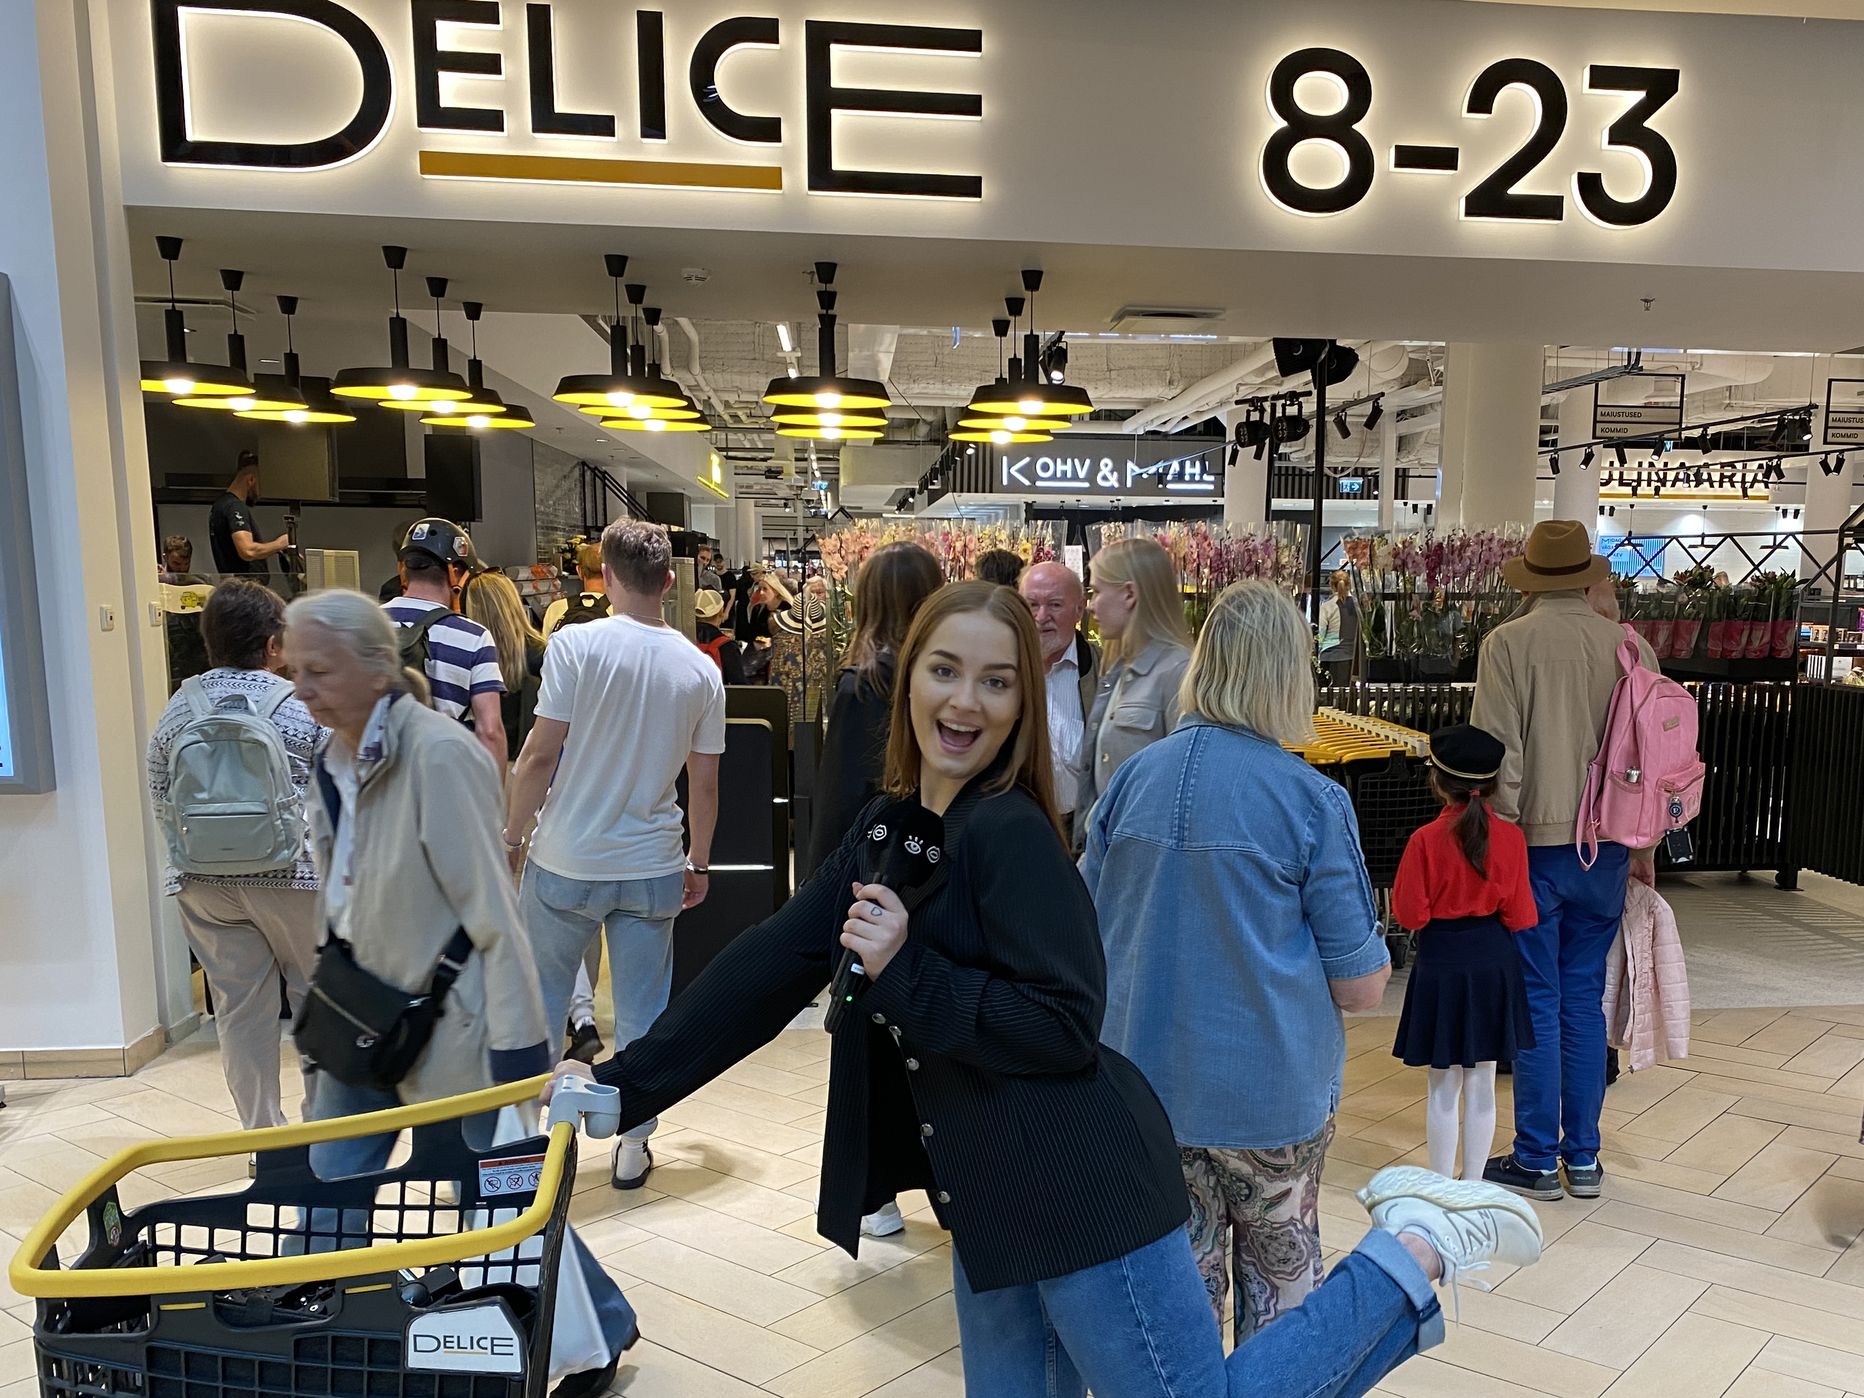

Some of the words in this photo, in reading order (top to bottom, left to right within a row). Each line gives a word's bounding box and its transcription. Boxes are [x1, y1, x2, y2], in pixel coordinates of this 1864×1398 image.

[152, 0, 983, 199] DELICE
[1261, 46, 1681, 228] 8-23
[1600, 410, 1642, 418] MAIUSTUSED
[1831, 416, 1864, 424] MAIUSTUS
[1002, 455, 1091, 487] KOHV
[1096, 457, 1120, 488] &
[1599, 461, 1770, 490] ULINAARIA
[413, 1333, 514, 1356] DELICE
